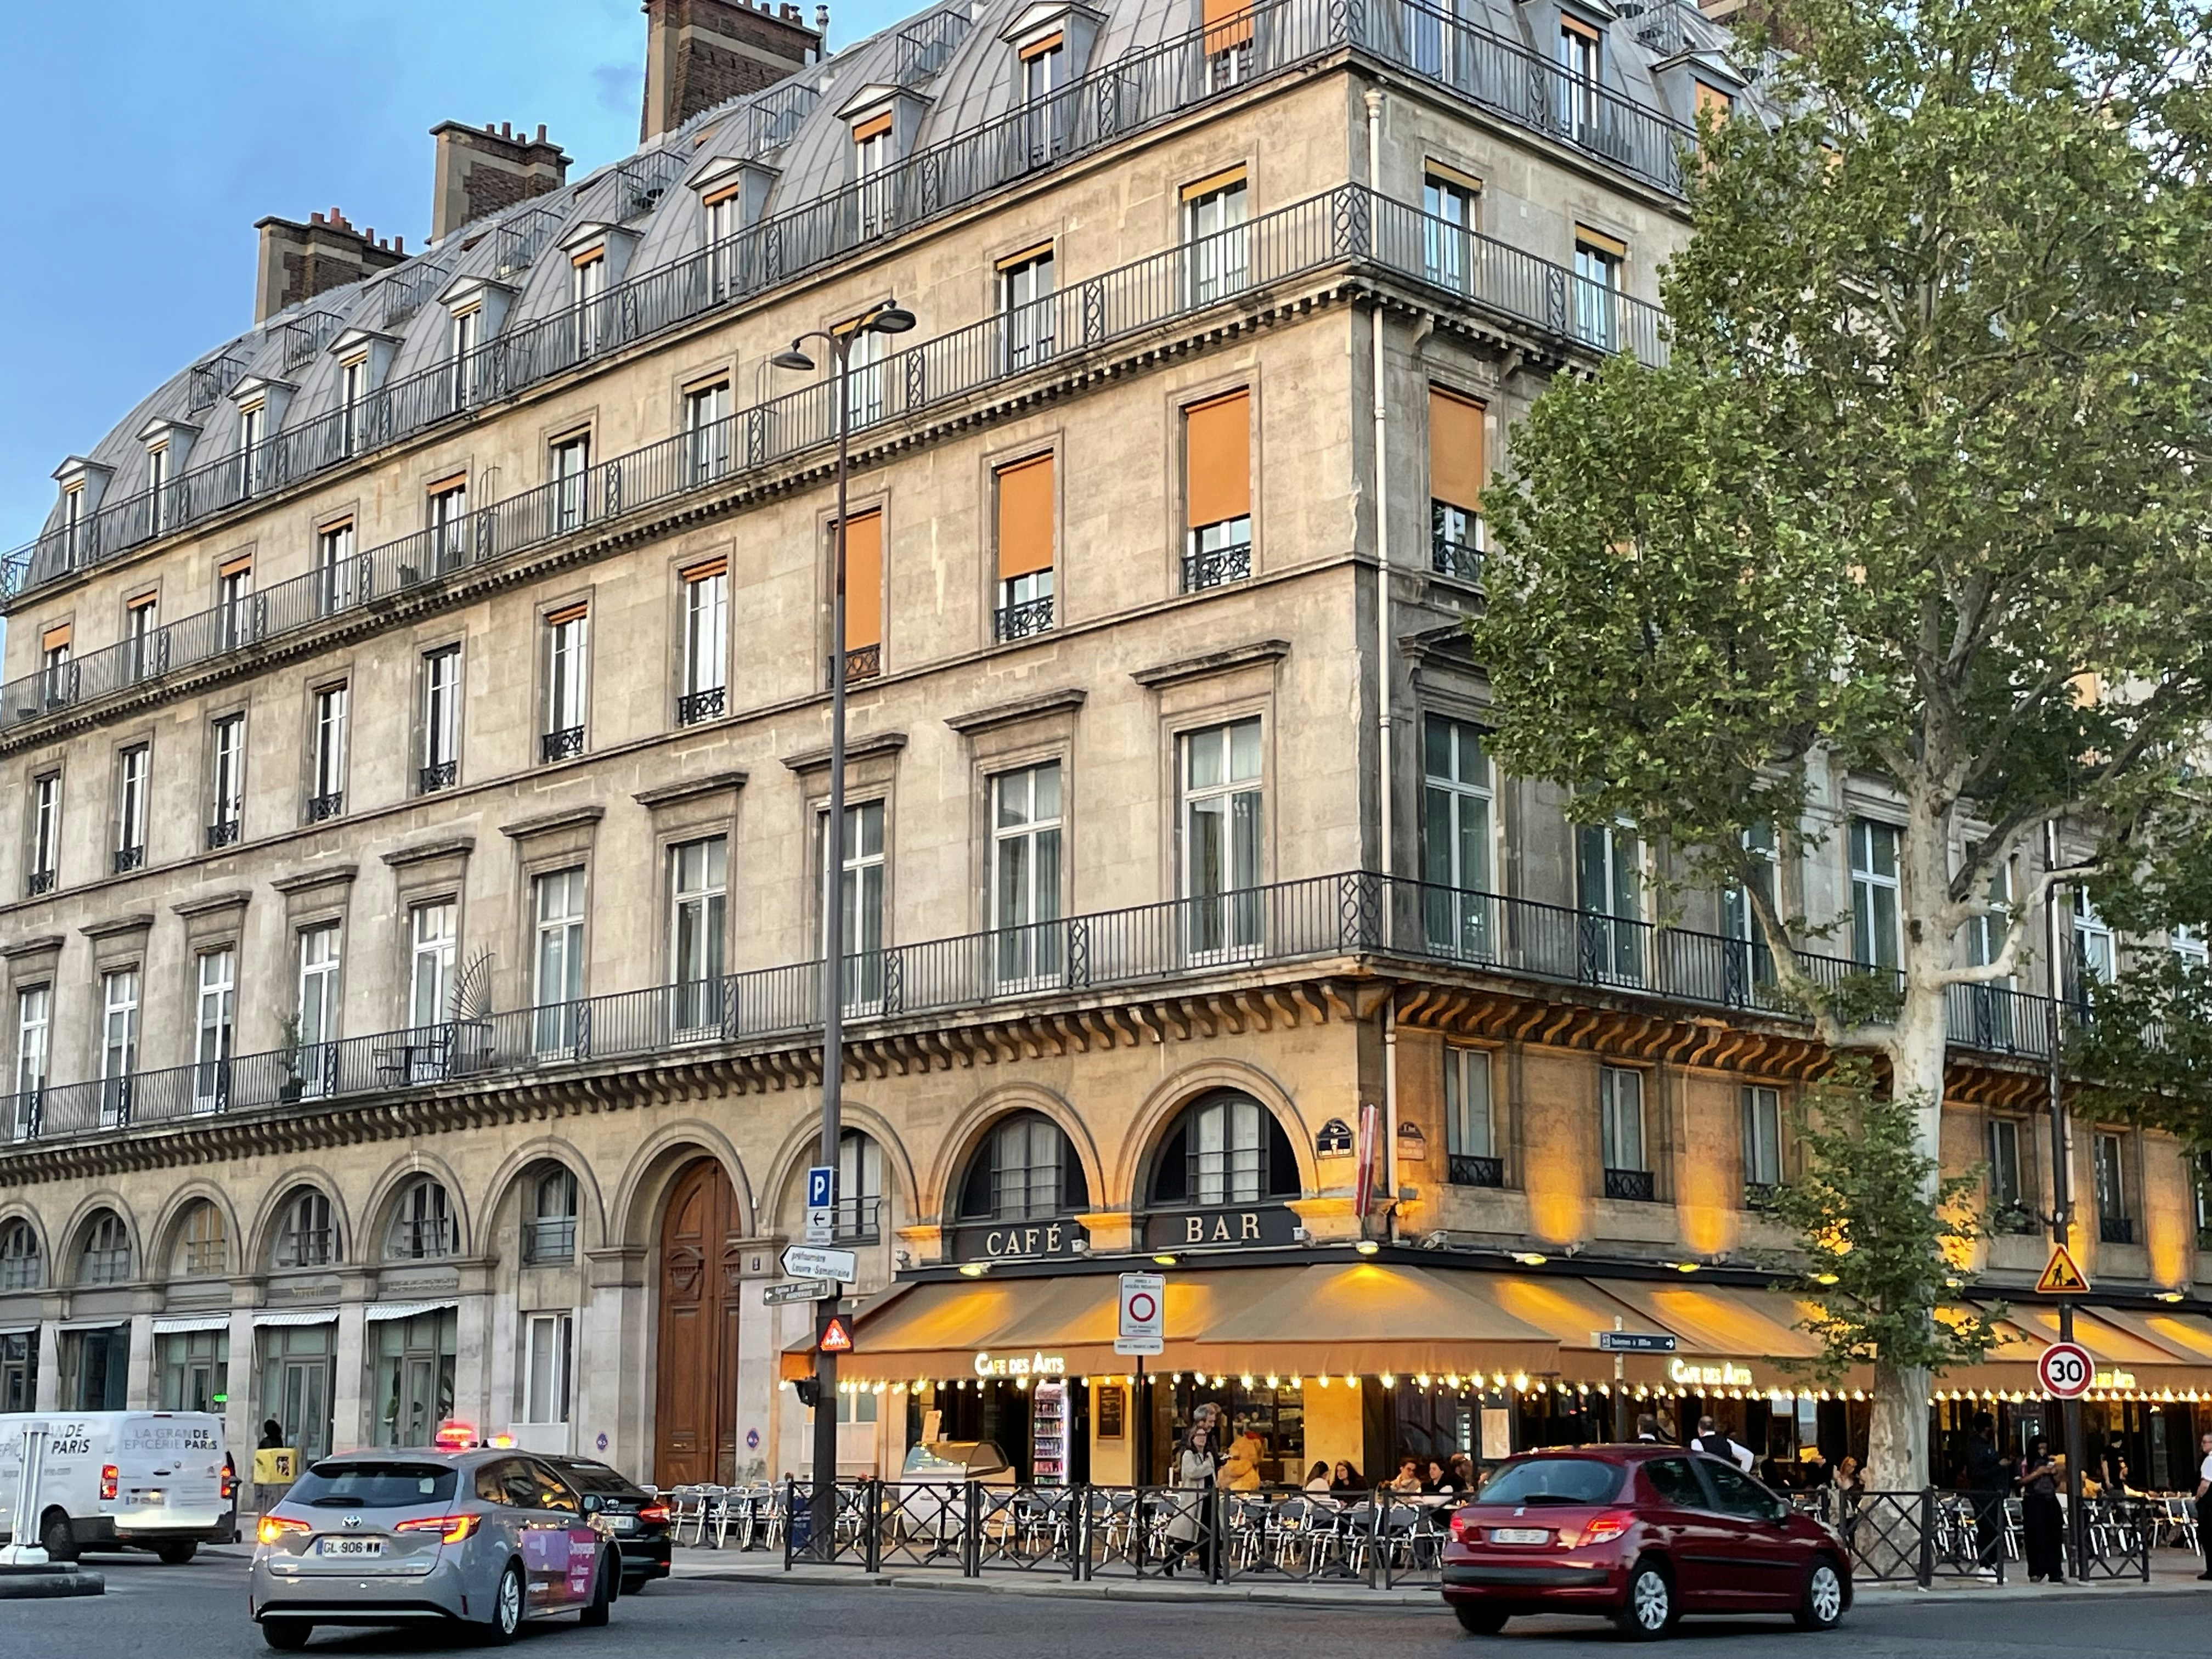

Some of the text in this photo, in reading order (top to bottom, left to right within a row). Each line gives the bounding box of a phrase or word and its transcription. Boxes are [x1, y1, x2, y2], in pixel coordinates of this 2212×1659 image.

[814, 1176, 826, 1201] P
[986, 1222, 1063, 1256] CAFÉ
[1185, 1212, 1261, 1243] BAR
[2051, 1359, 2083, 1382] 30
[156, 1429, 209, 1439] GRANDE
[185, 1439, 218, 1450] PARIS
[51, 1438, 91, 1455] PARIS
